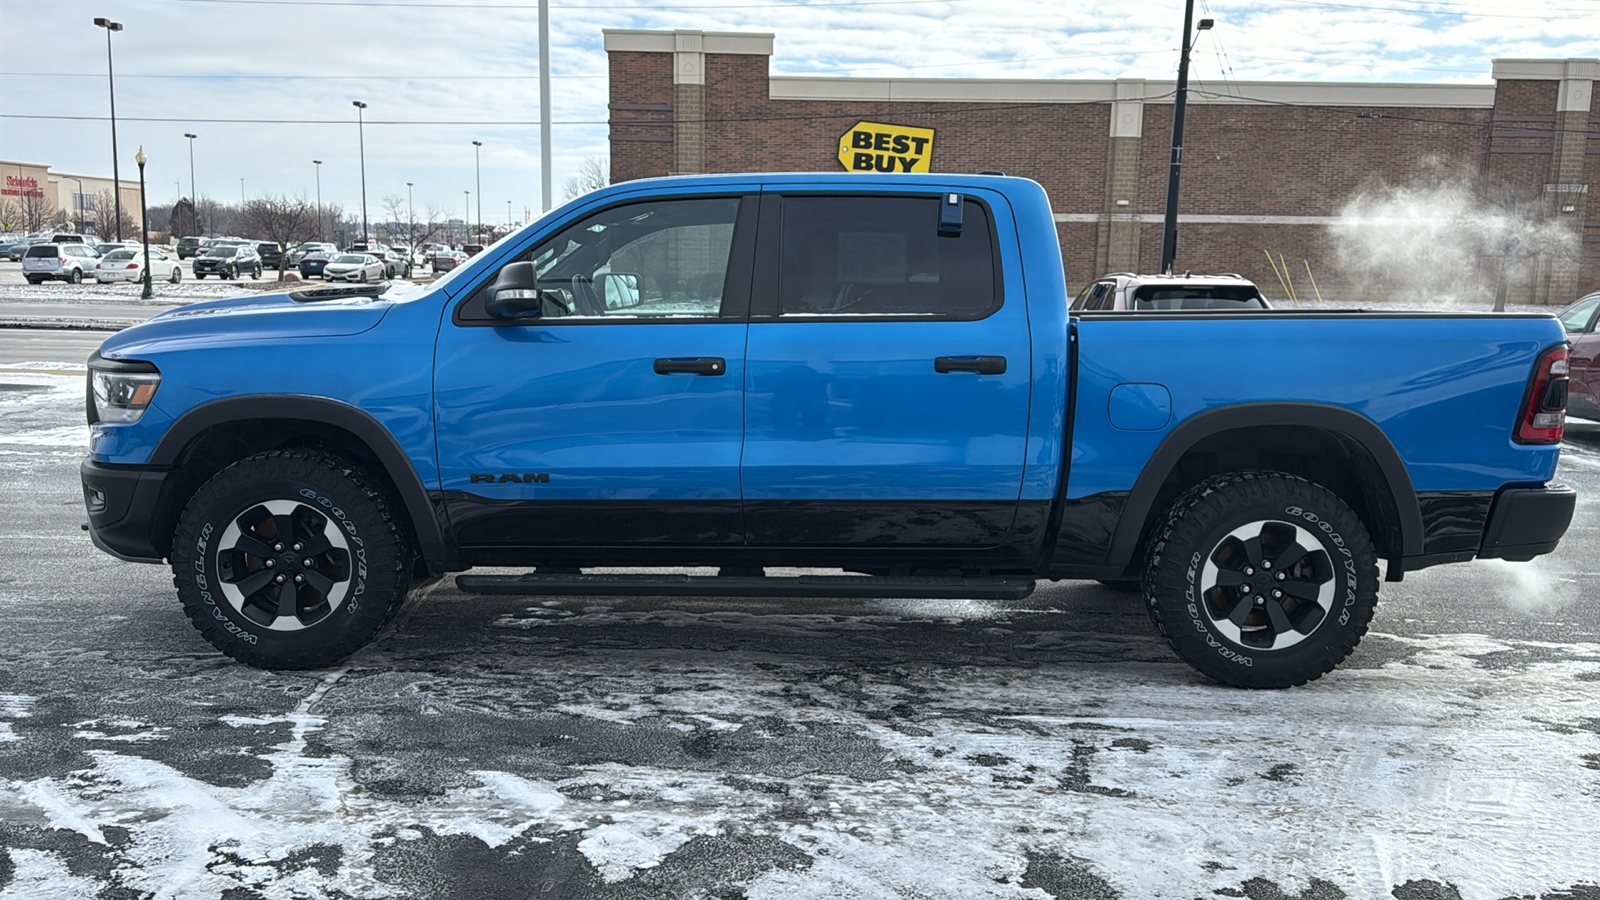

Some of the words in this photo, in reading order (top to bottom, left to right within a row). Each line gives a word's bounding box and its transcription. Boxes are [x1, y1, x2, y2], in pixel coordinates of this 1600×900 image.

[852, 131, 929, 155] BEST
[853, 152, 920, 173] BUY
[470, 473, 549, 484] RAM
[194, 522, 258, 645] WRANGLER
[300, 488, 368, 614] GOODYEAR
[1186, 551, 1253, 667] WRANGLER
[1285, 506, 1357, 627] GOODYEAR
